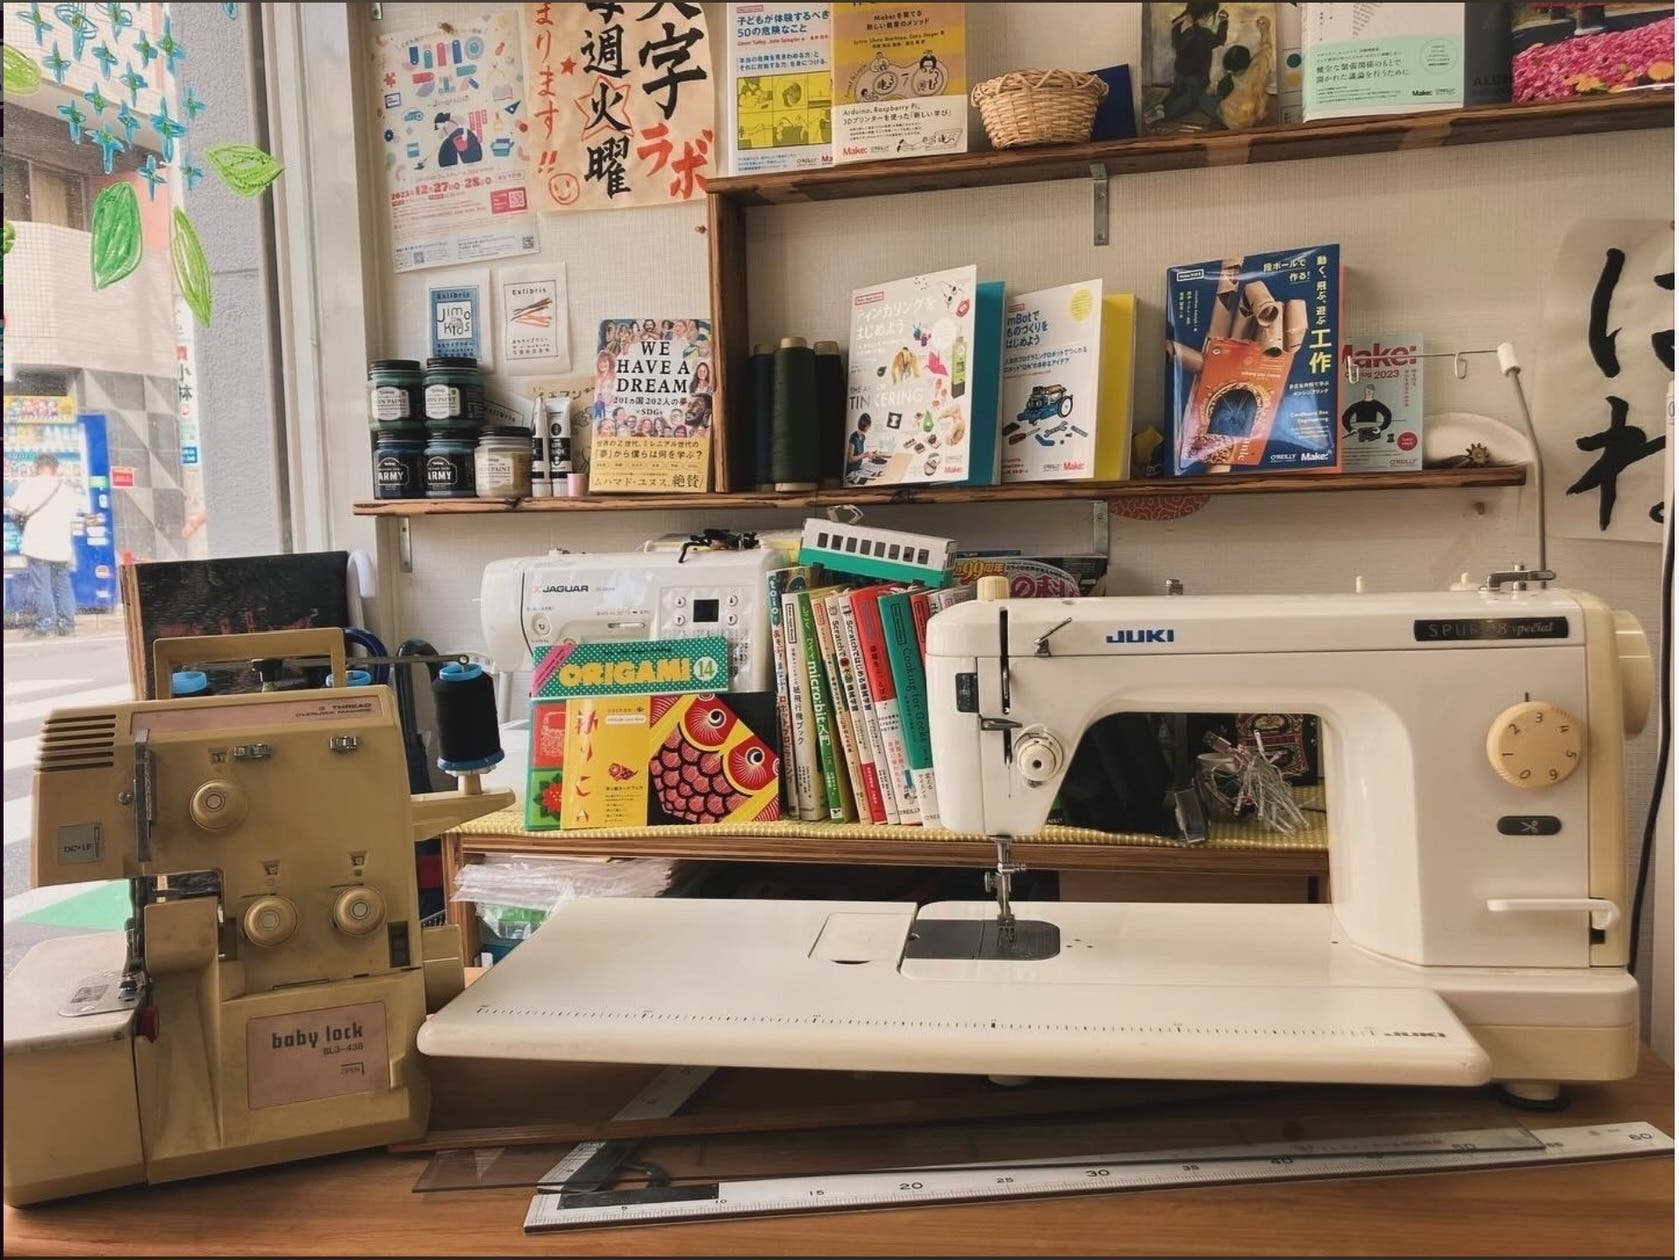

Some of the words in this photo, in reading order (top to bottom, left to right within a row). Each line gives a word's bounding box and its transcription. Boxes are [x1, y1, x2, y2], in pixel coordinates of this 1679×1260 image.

[738, 10, 830, 25] 子どもが体験するべき
[737, 24, 807, 38] 50の危険なこと
[842, 146, 867, 156] Make:
[1264, 258, 1307, 273] 段ボールで
[1007, 310, 1039, 326] mBotで
[1007, 320, 1048, 337] ものづくりを
[641, 341, 671, 356] WE
[1006, 336, 1040, 349] はじめよう
[617, 360, 671, 374] HAVE
[678, 360, 690, 374] A
[1374, 370, 1400, 379] 2023
[616, 378, 688, 393] DREAM
[1301, 453, 1328, 461] Make:
[542, 585, 589, 593] JAGUAR
[1106, 629, 1174, 643] JUKI
[560, 657, 691, 687] ORIGAMI
[698, 660, 715, 678] 14
[846, 620, 872, 711] Scratchではじめる機械学習
[332, 702, 372, 710] THREAD
[1535, 712, 1544, 723] 3
[1508, 723, 1521, 735] 2
[1566, 750, 1577, 759] 5
[1519, 769, 1531, 780] 0
[1549, 769, 1559, 781] 6
[272, 1029, 318, 1049] baby
[326, 1022, 363, 1042] lock
[810, 1189, 825, 1197] 15
[899, 1181, 923, 1191] 20
[997, 1176, 1015, 1184] 25
[1086, 1169, 1110, 1177] 30
[1182, 1163, 1200, 1171] 35
[1628, 1132, 1652, 1142] 60
